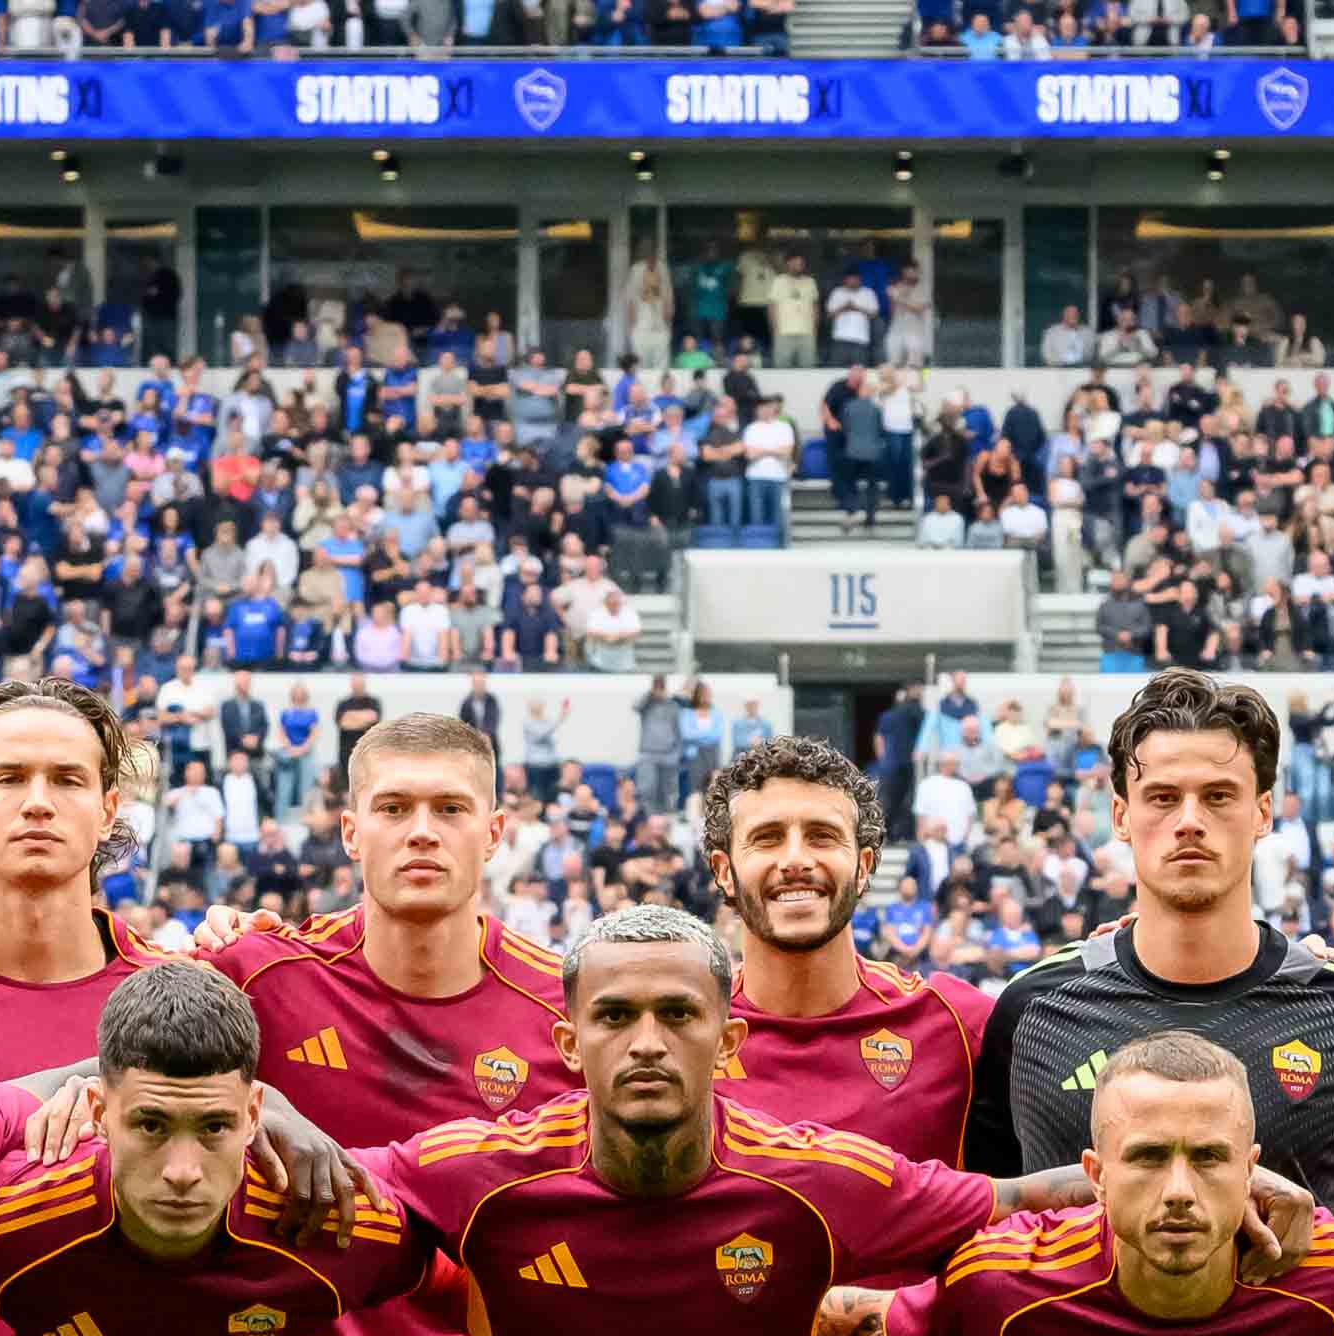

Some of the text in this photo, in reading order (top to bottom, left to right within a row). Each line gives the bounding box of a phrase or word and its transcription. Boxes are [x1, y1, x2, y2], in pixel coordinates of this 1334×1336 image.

[296, 74, 439, 123] STARTING
[666, 74, 809, 123] STARTING
[1036, 74, 1180, 123] STARTING
[829, 573, 878, 617] 115
[478, 1080, 517, 1097] ROMA
[1280, 1071, 1314, 1086] ROMA
[723, 1271, 766, 1287] ROMA
